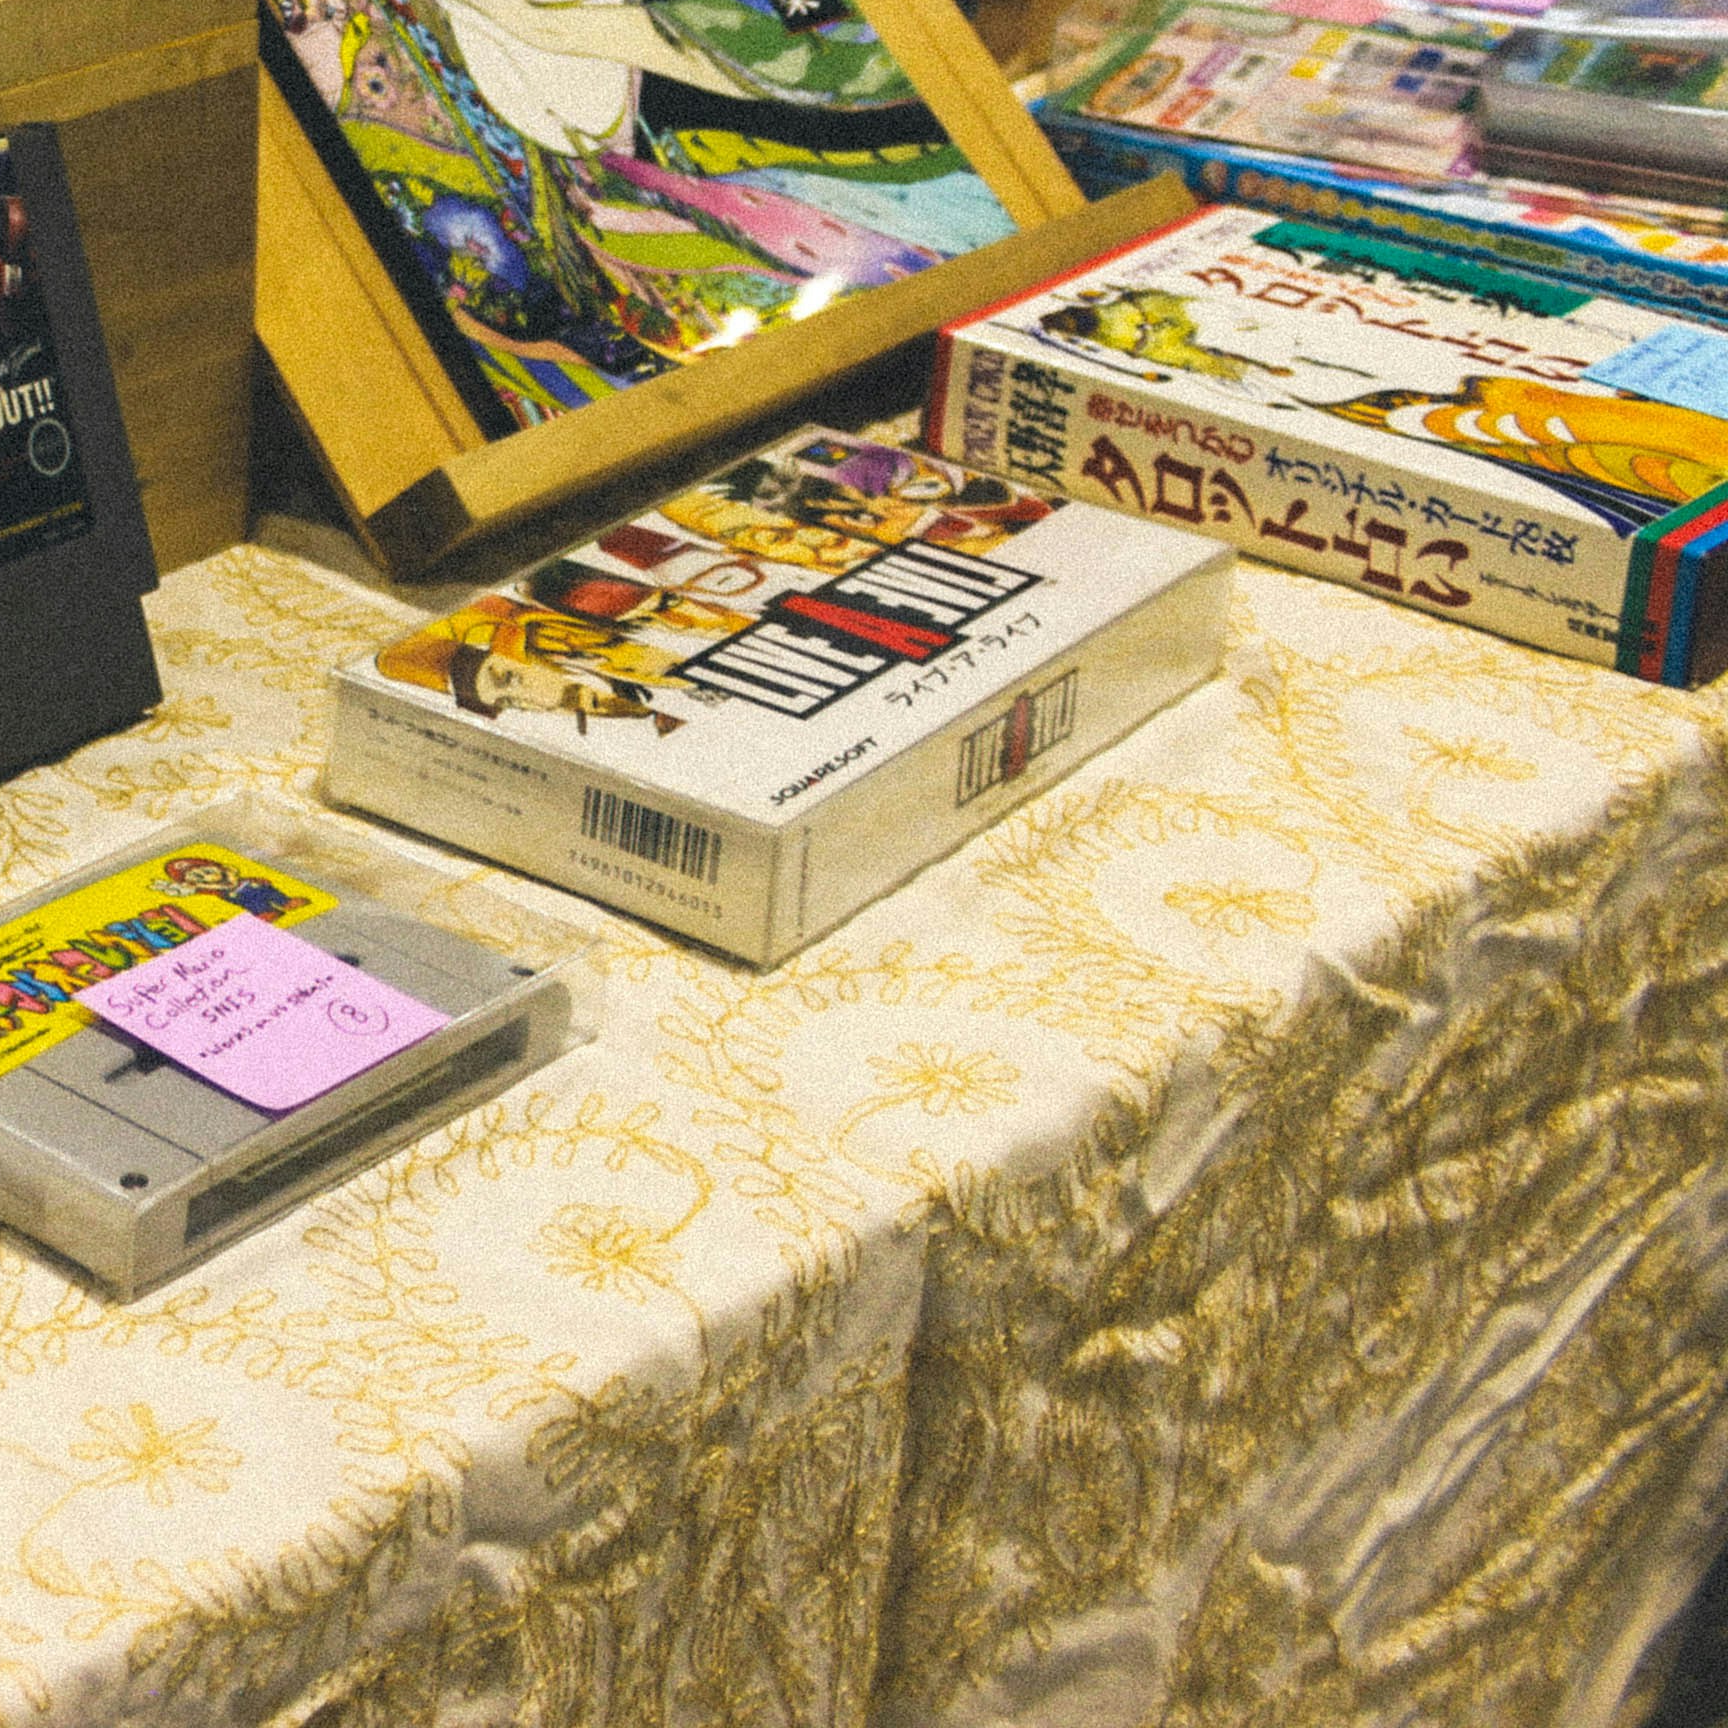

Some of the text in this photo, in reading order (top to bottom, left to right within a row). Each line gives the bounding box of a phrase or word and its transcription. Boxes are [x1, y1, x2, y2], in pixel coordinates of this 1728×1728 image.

[1080, 433, 1475, 609] タロット占い
[674, 617, 894, 719] LIVE
[769, 734, 879, 808] SQUARESOFT
[106, 946, 226, 1020] Super Mario
[144, 967, 248, 1033] Collection
